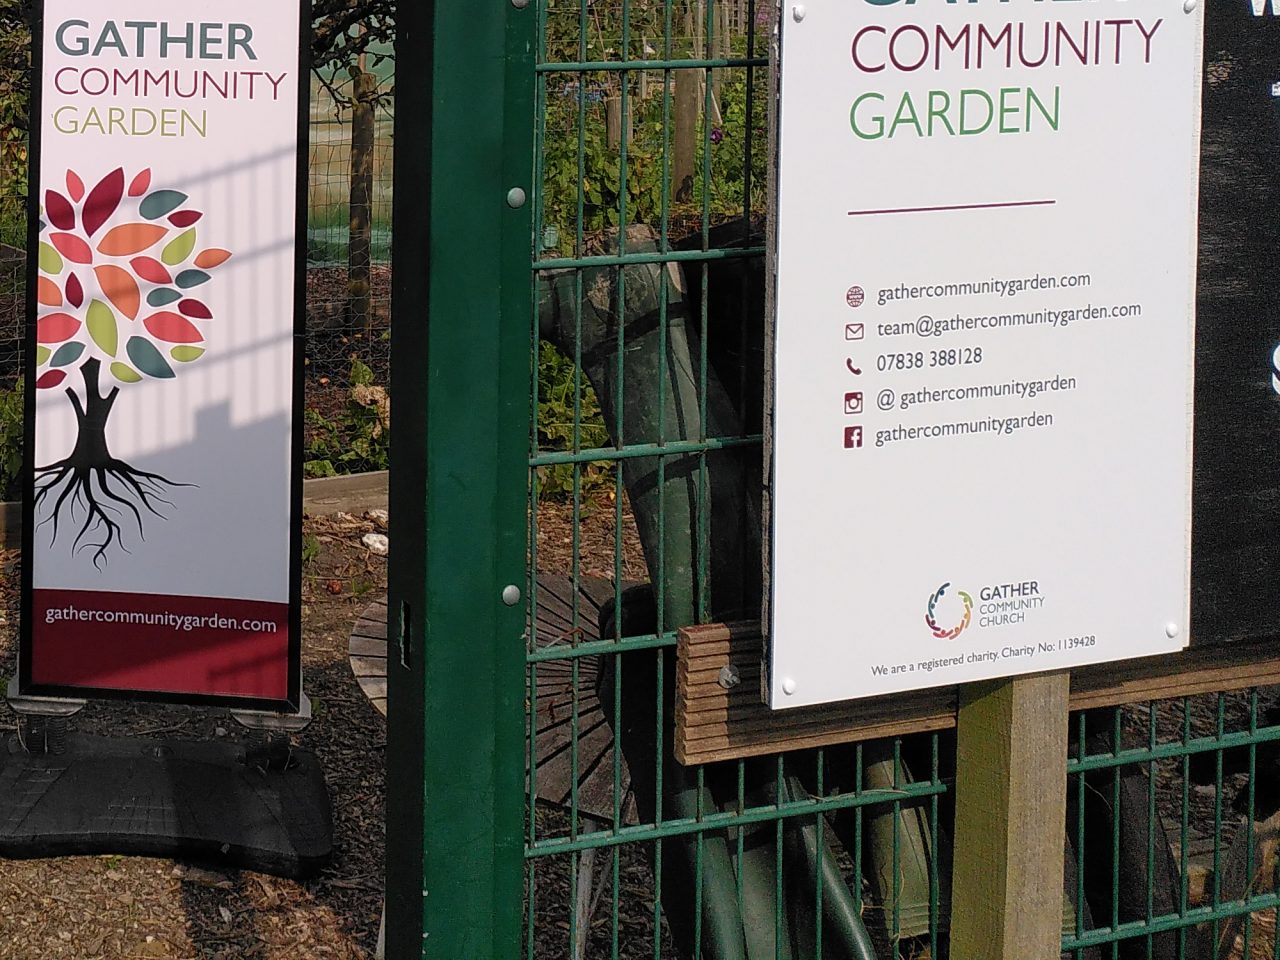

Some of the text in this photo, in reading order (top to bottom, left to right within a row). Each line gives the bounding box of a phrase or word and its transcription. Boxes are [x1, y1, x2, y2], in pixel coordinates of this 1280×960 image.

[55, 19, 258, 60] GATHER
[851, 18, 1163, 73] COMMUNITY
[54, 67, 287, 100] COMMUNITY
[53, 106, 207, 137] GARDEN
[850, 86, 1060, 140] GARDEN
[877, 272, 1091, 305] gathercommunitygarden.com
[877, 301, 1141, 338] team@gathercommunitygarden.com
[877, 347, 982, 372] 07838 388128
[900, 375, 1076, 407] gathercommunitygarden
[876, 411, 1052, 447] gathercommunitygarden
[979, 597, 1045, 615] COMMUNITY
[980, 581, 1039, 601] GATHER
[45, 605, 277, 633] gathercommunitygarden.com
[979, 612, 1025, 627] CHURCH
[871, 665, 888, 676] We
[891, 665, 907, 674] are
[909, 664, 914, 672] a
[917, 654, 964, 672] registered
[1001, 645, 1035, 659] Charity
[1038, 642, 1055, 654] No:
[1058, 635, 1096, 650] 1139428
